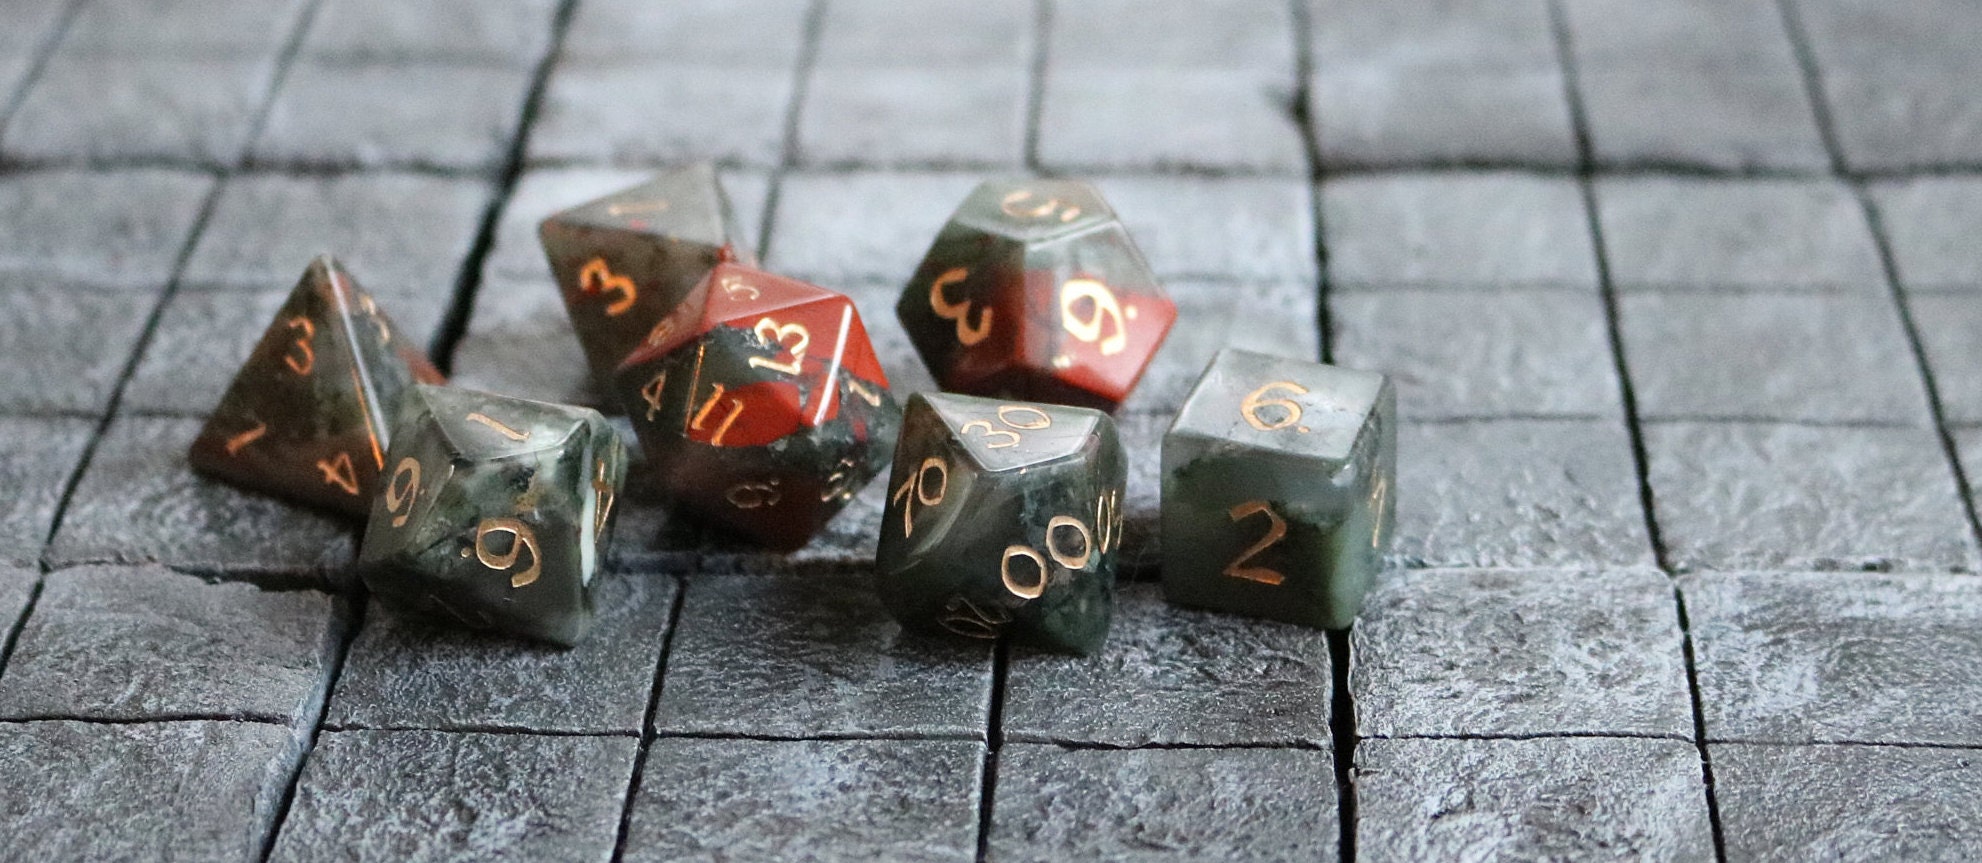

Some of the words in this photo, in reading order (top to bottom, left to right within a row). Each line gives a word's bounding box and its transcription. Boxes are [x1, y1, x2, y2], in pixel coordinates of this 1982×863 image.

[580, 258, 637, 317] 3
[930, 267, 993, 346] 3
[286, 316, 316, 377] 3
[749, 317, 811, 376] 13
[691, 382, 744, 446] 11
[961, 405, 1051, 449] 30
[1240, 380, 1311, 433] 6
[317, 453, 360, 495] 4
[893, 457, 948, 538] 70
[1001, 515, 1092, 600] 00
[1223, 501, 1288, 586] 2
